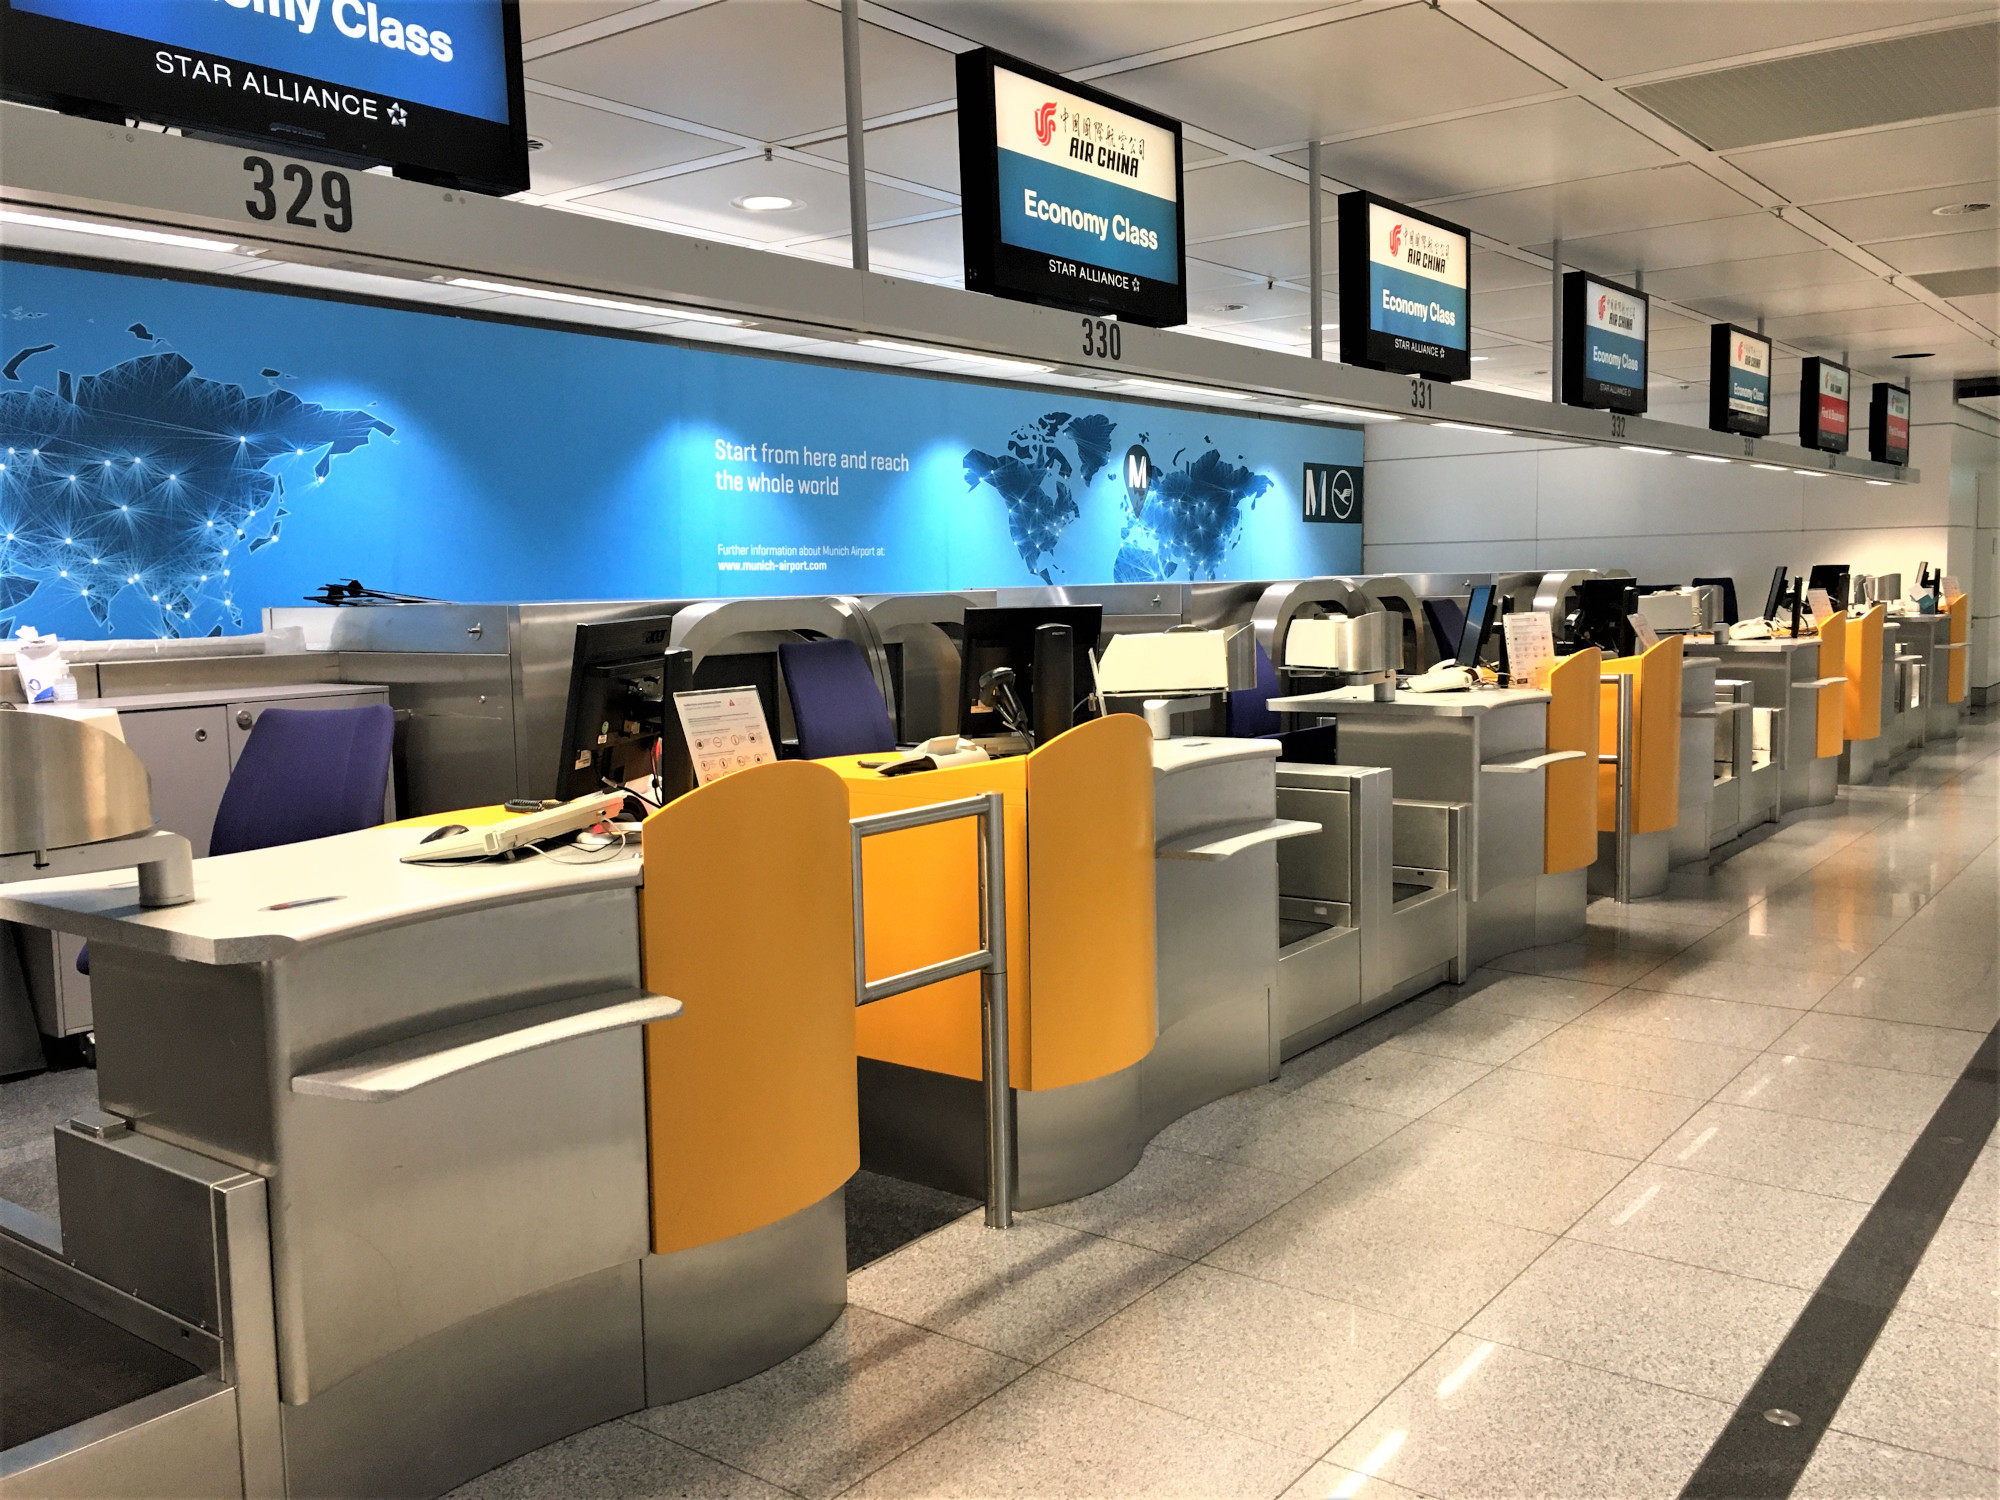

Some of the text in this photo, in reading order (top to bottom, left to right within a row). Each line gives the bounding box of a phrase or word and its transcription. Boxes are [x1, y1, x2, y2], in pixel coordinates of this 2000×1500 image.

[155, 51, 378, 120] STAR ALLIANCE
[1069, 137, 1139, 178] AIR CHINA
[243, 155, 353, 233] 329
[1023, 188, 1159, 251] Economy Class
[1048, 259, 1130, 290] STAR ALLIANCE
[1407, 248, 1446, 274] AIR CHINA
[1382, 288, 1456, 327] Economy Class
[1081, 318, 1122, 361] 330
[1394, 338, 1439, 357] STAR ALLIANCE
[1593, 345, 1639, 372] Economy Class
[1411, 379, 1432, 410] 331
[1611, 415, 1626, 437] 332
[714, 438, 910, 472] Start from here and reach
[715, 469, 839, 496] the whole world
[1129, 454, 1147, 489] M
[717, 543, 886, 559] Further information about Munich Airport at:
[717, 560, 828, 574] www.munich-airport.com
